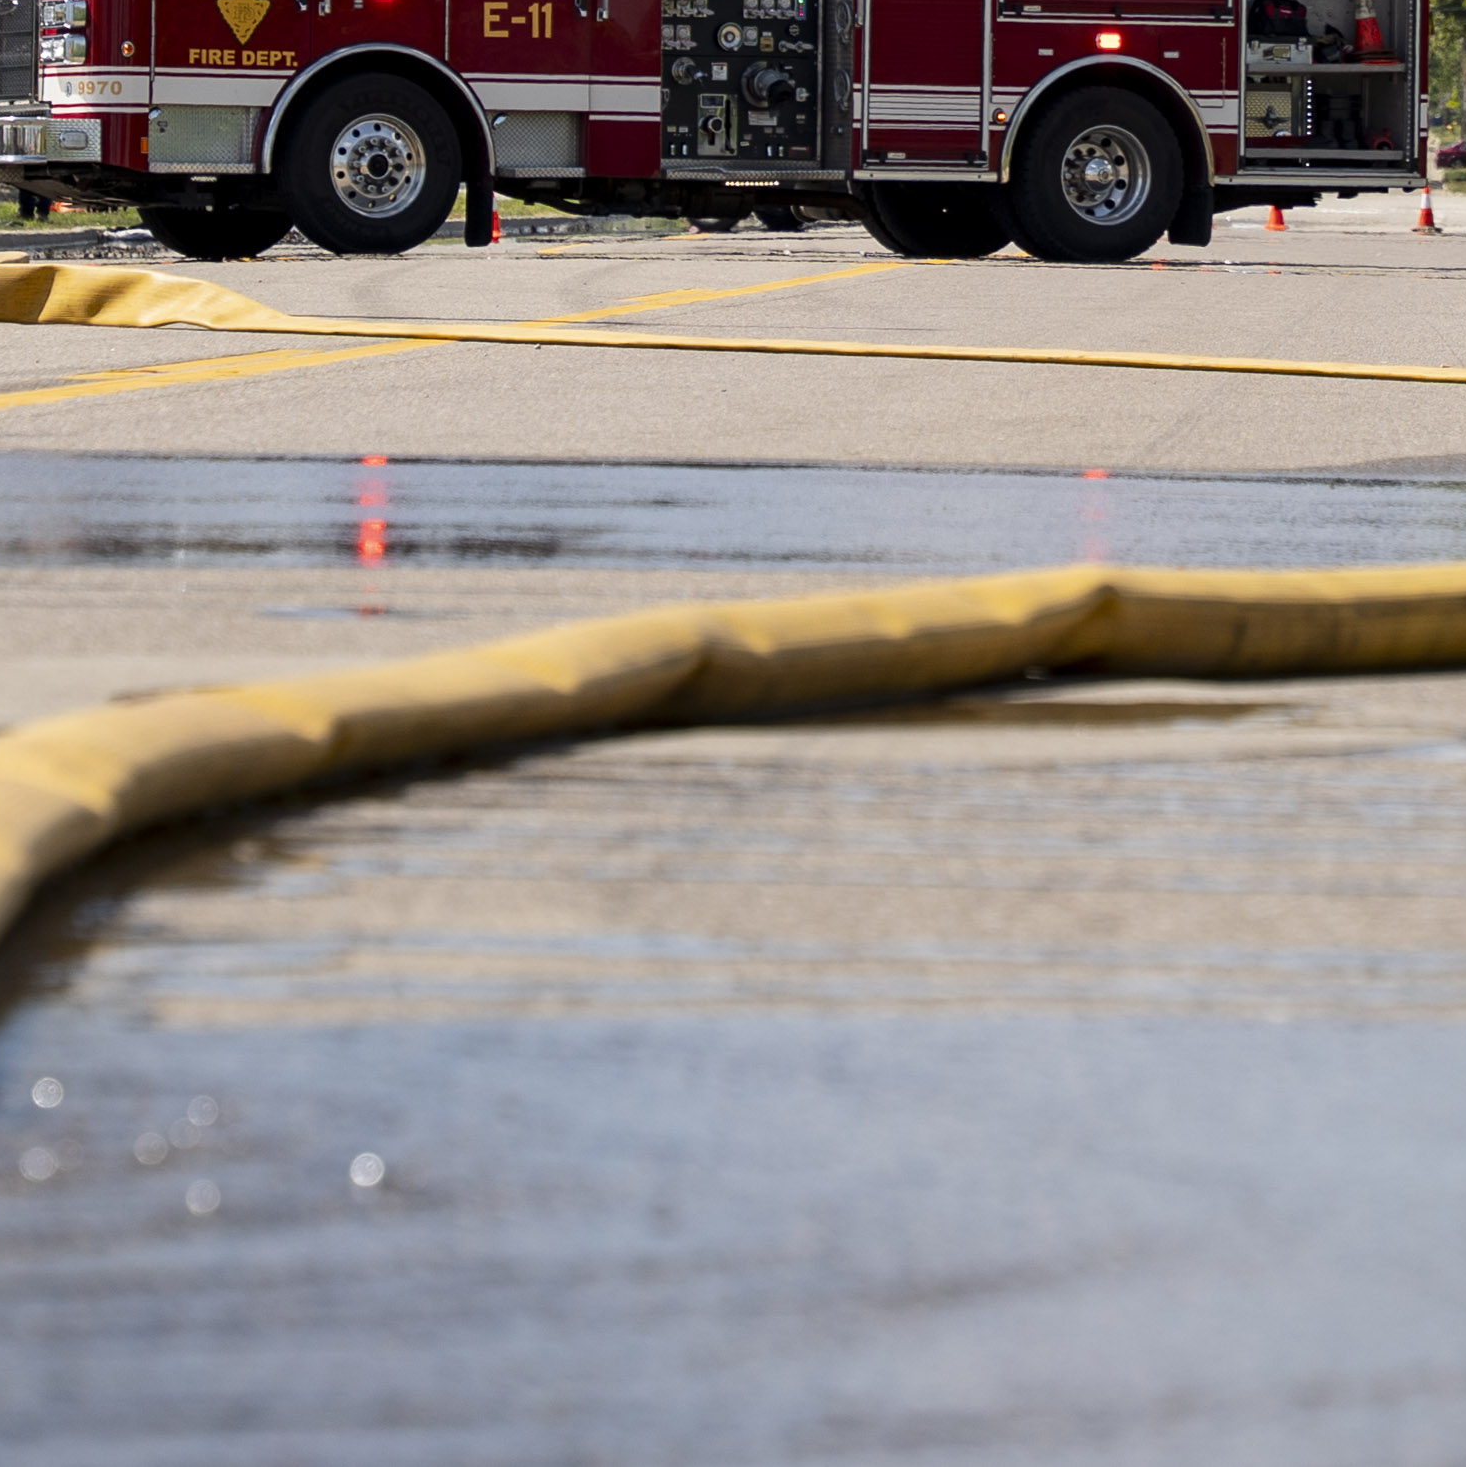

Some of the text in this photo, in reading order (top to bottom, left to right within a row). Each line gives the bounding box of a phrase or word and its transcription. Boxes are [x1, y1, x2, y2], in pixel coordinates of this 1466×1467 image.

[483, 2, 553, 39] E-11
[189, 48, 299, 67] FIRE DEPT.
[78, 80, 123, 96] 9970
